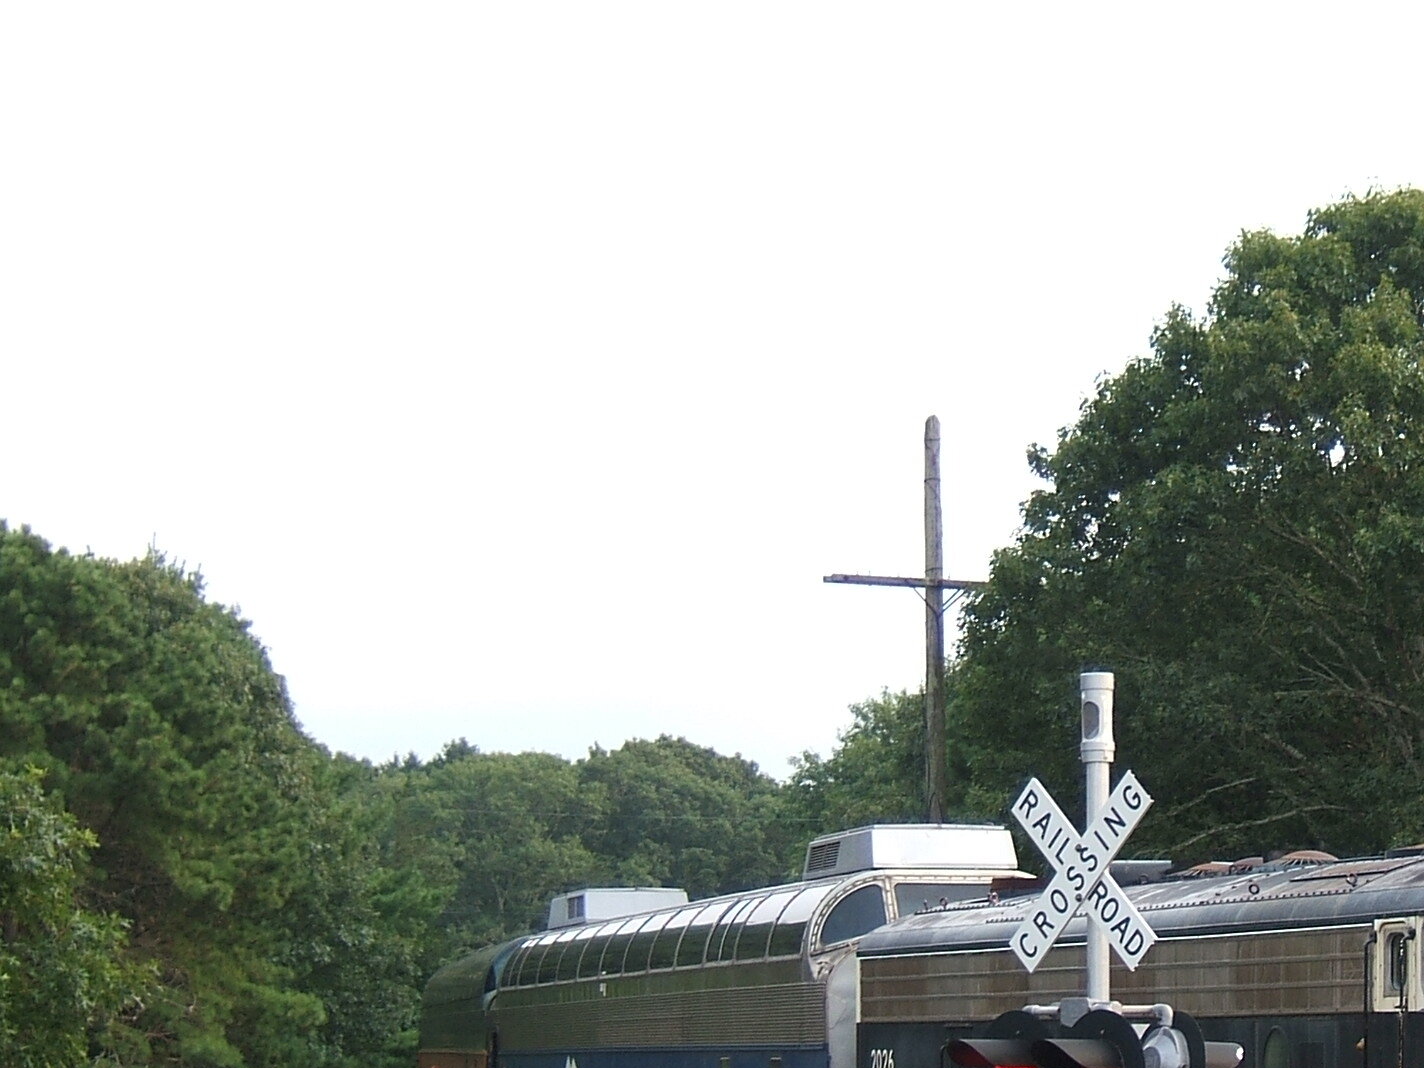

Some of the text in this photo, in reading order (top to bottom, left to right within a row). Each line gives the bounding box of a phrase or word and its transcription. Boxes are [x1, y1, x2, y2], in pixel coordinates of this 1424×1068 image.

[1018, 789, 1070, 866] RAIL
[1019, 785, 1142, 958] CROSSING
[1087, 880, 1144, 957] ROAD
